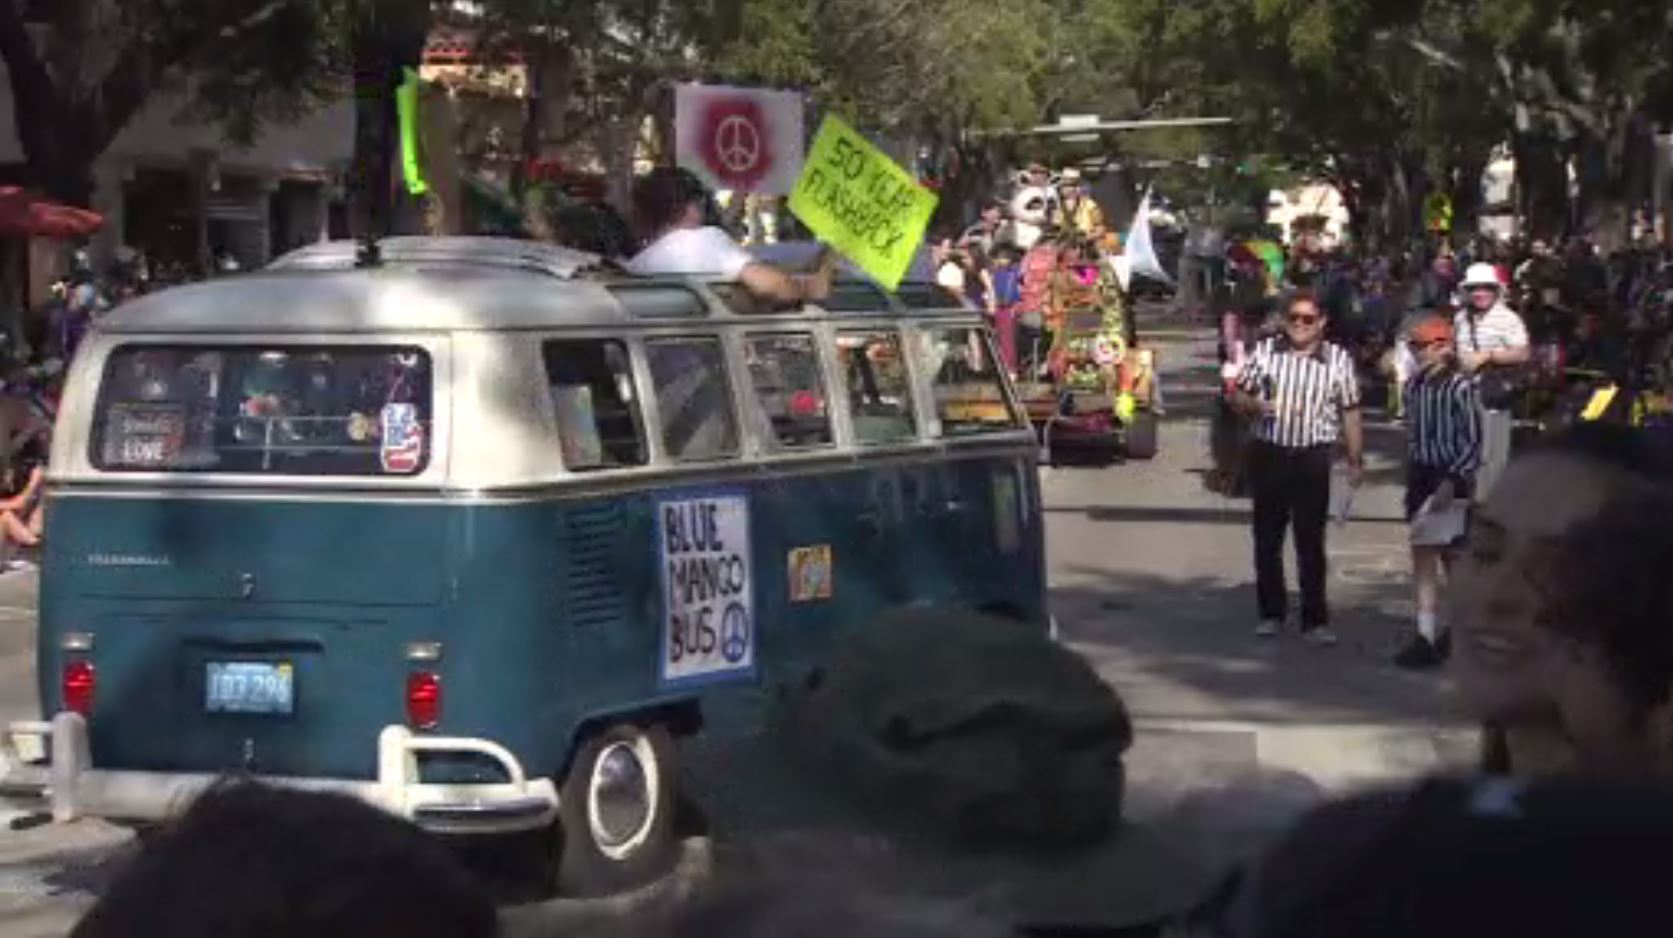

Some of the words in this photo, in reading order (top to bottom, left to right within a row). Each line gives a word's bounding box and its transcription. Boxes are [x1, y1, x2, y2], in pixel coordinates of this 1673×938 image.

[826, 136, 864, 180] 50
[666, 504, 722, 553] BLUE
[669, 554, 744, 605] MANGO
[671, 606, 717, 662] BUS
